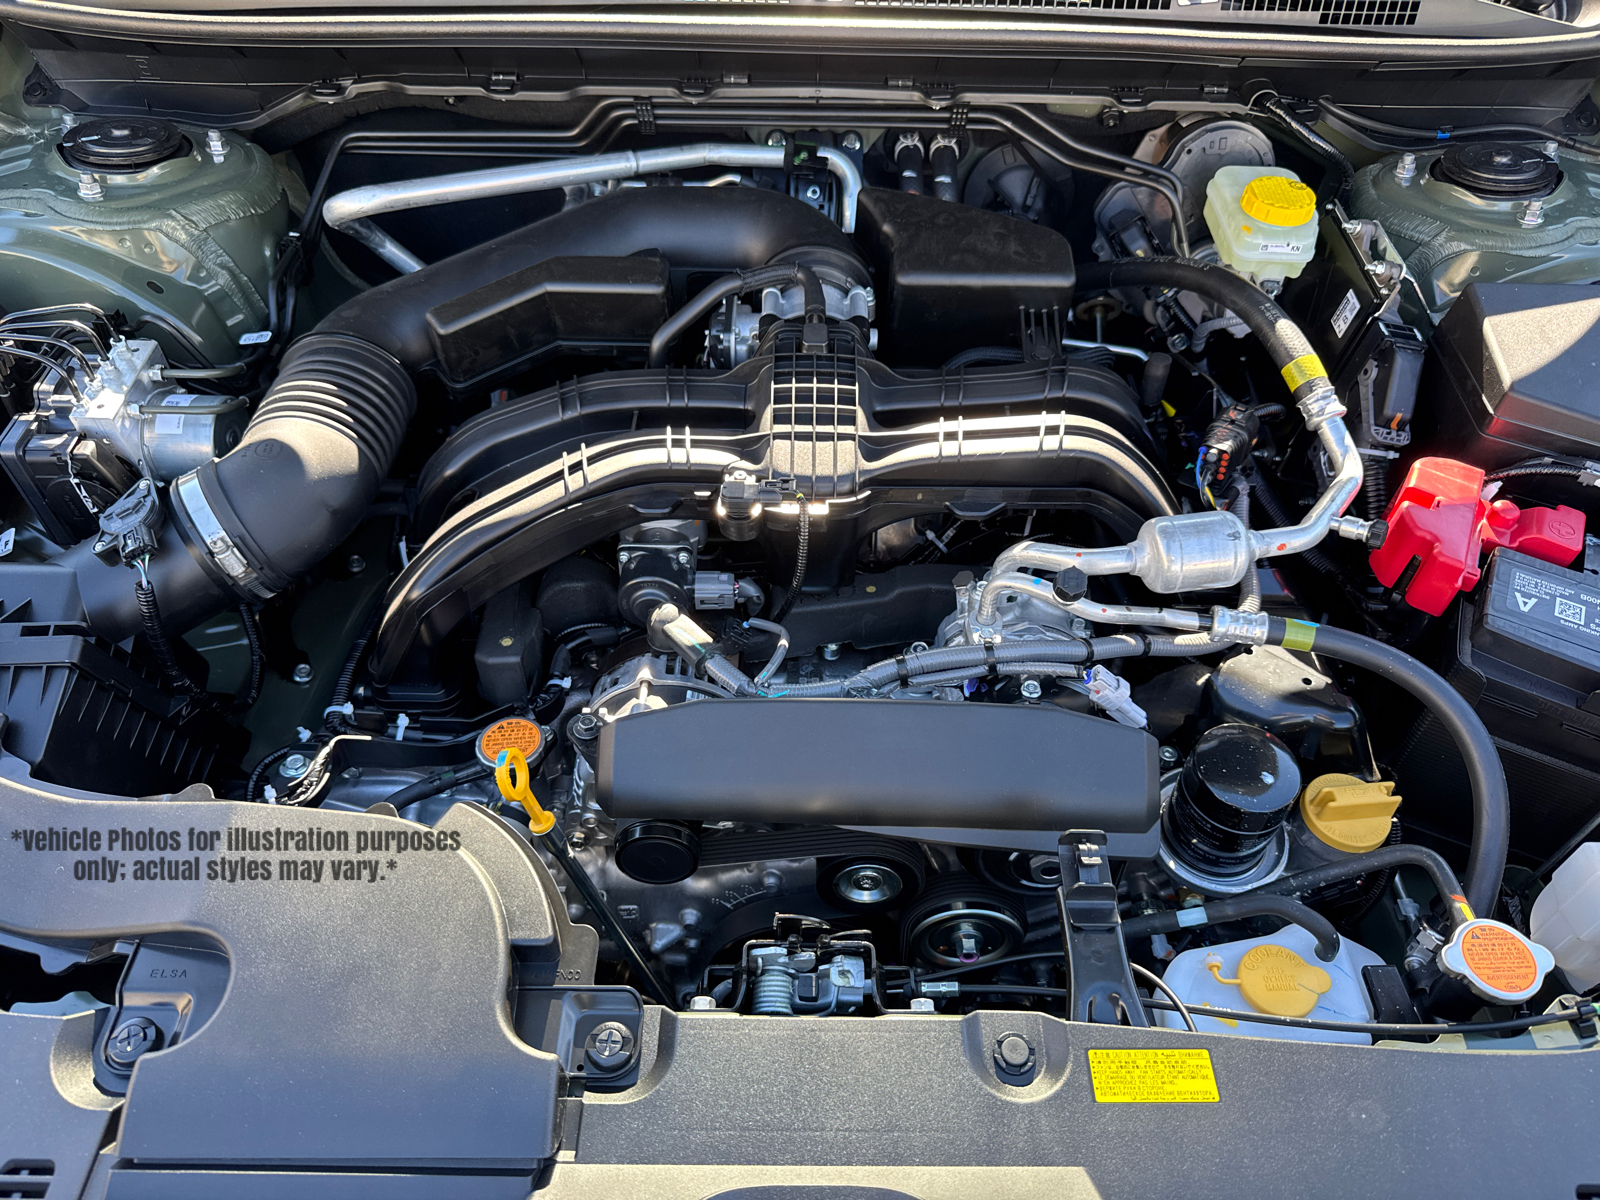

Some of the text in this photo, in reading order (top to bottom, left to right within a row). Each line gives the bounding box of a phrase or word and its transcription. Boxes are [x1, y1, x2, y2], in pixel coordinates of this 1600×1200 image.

[1514, 592, 1538, 612] A
[1560, 619, 1600, 637] NKING AMPS
[1244, 947, 1307, 971] COOLANT
[150, 969, 187, 978] ELSA
[1266, 966, 1285, 975] SEE
[1265, 983, 1300, 992] MANUAL
[1112, 1051, 1132, 1059] CAUTION
